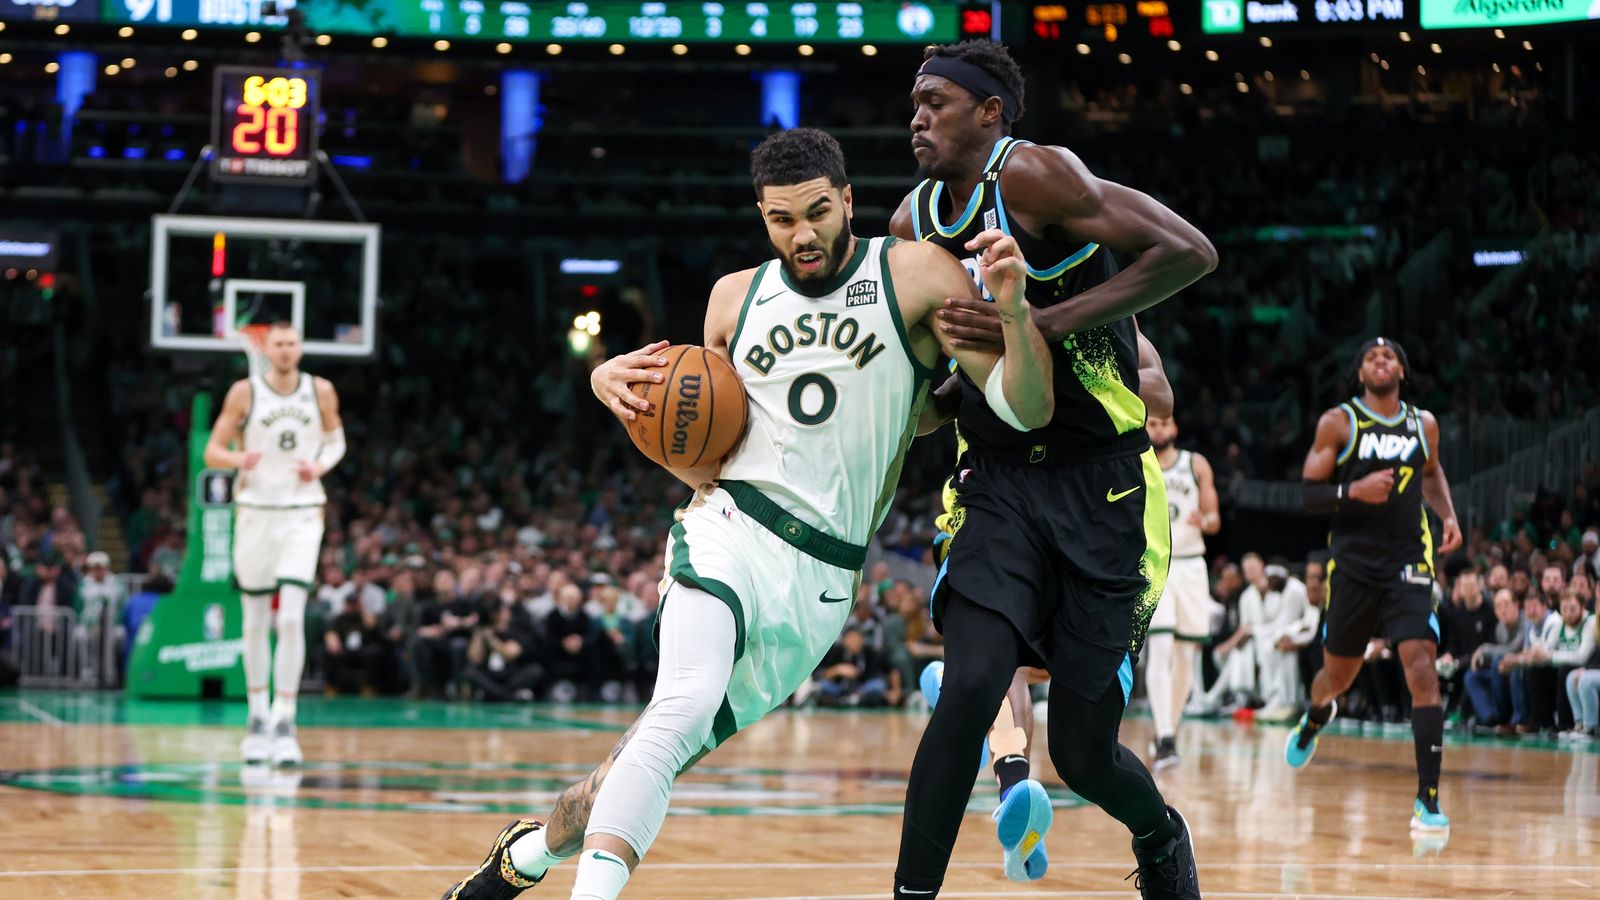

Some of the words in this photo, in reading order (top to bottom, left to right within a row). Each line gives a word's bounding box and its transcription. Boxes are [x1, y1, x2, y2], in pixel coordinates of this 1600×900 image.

[1247, 0, 1298, 23] Bank
[1367, 0, 1403, 20] PM
[243, 75, 307, 109] 6:03
[232, 104, 298, 155] 20
[986, 171, 998, 181] 30
[847, 293, 877, 307] PRINT
[848, 281, 876, 297] VISTA
[743, 311, 886, 377] BOSTON
[787, 371, 838, 426] 0
[671, 373, 702, 455] Wilson
[280, 431, 296, 450] 8
[1357, 432, 1420, 463] INDY
[1397, 465, 1415, 495] 7
